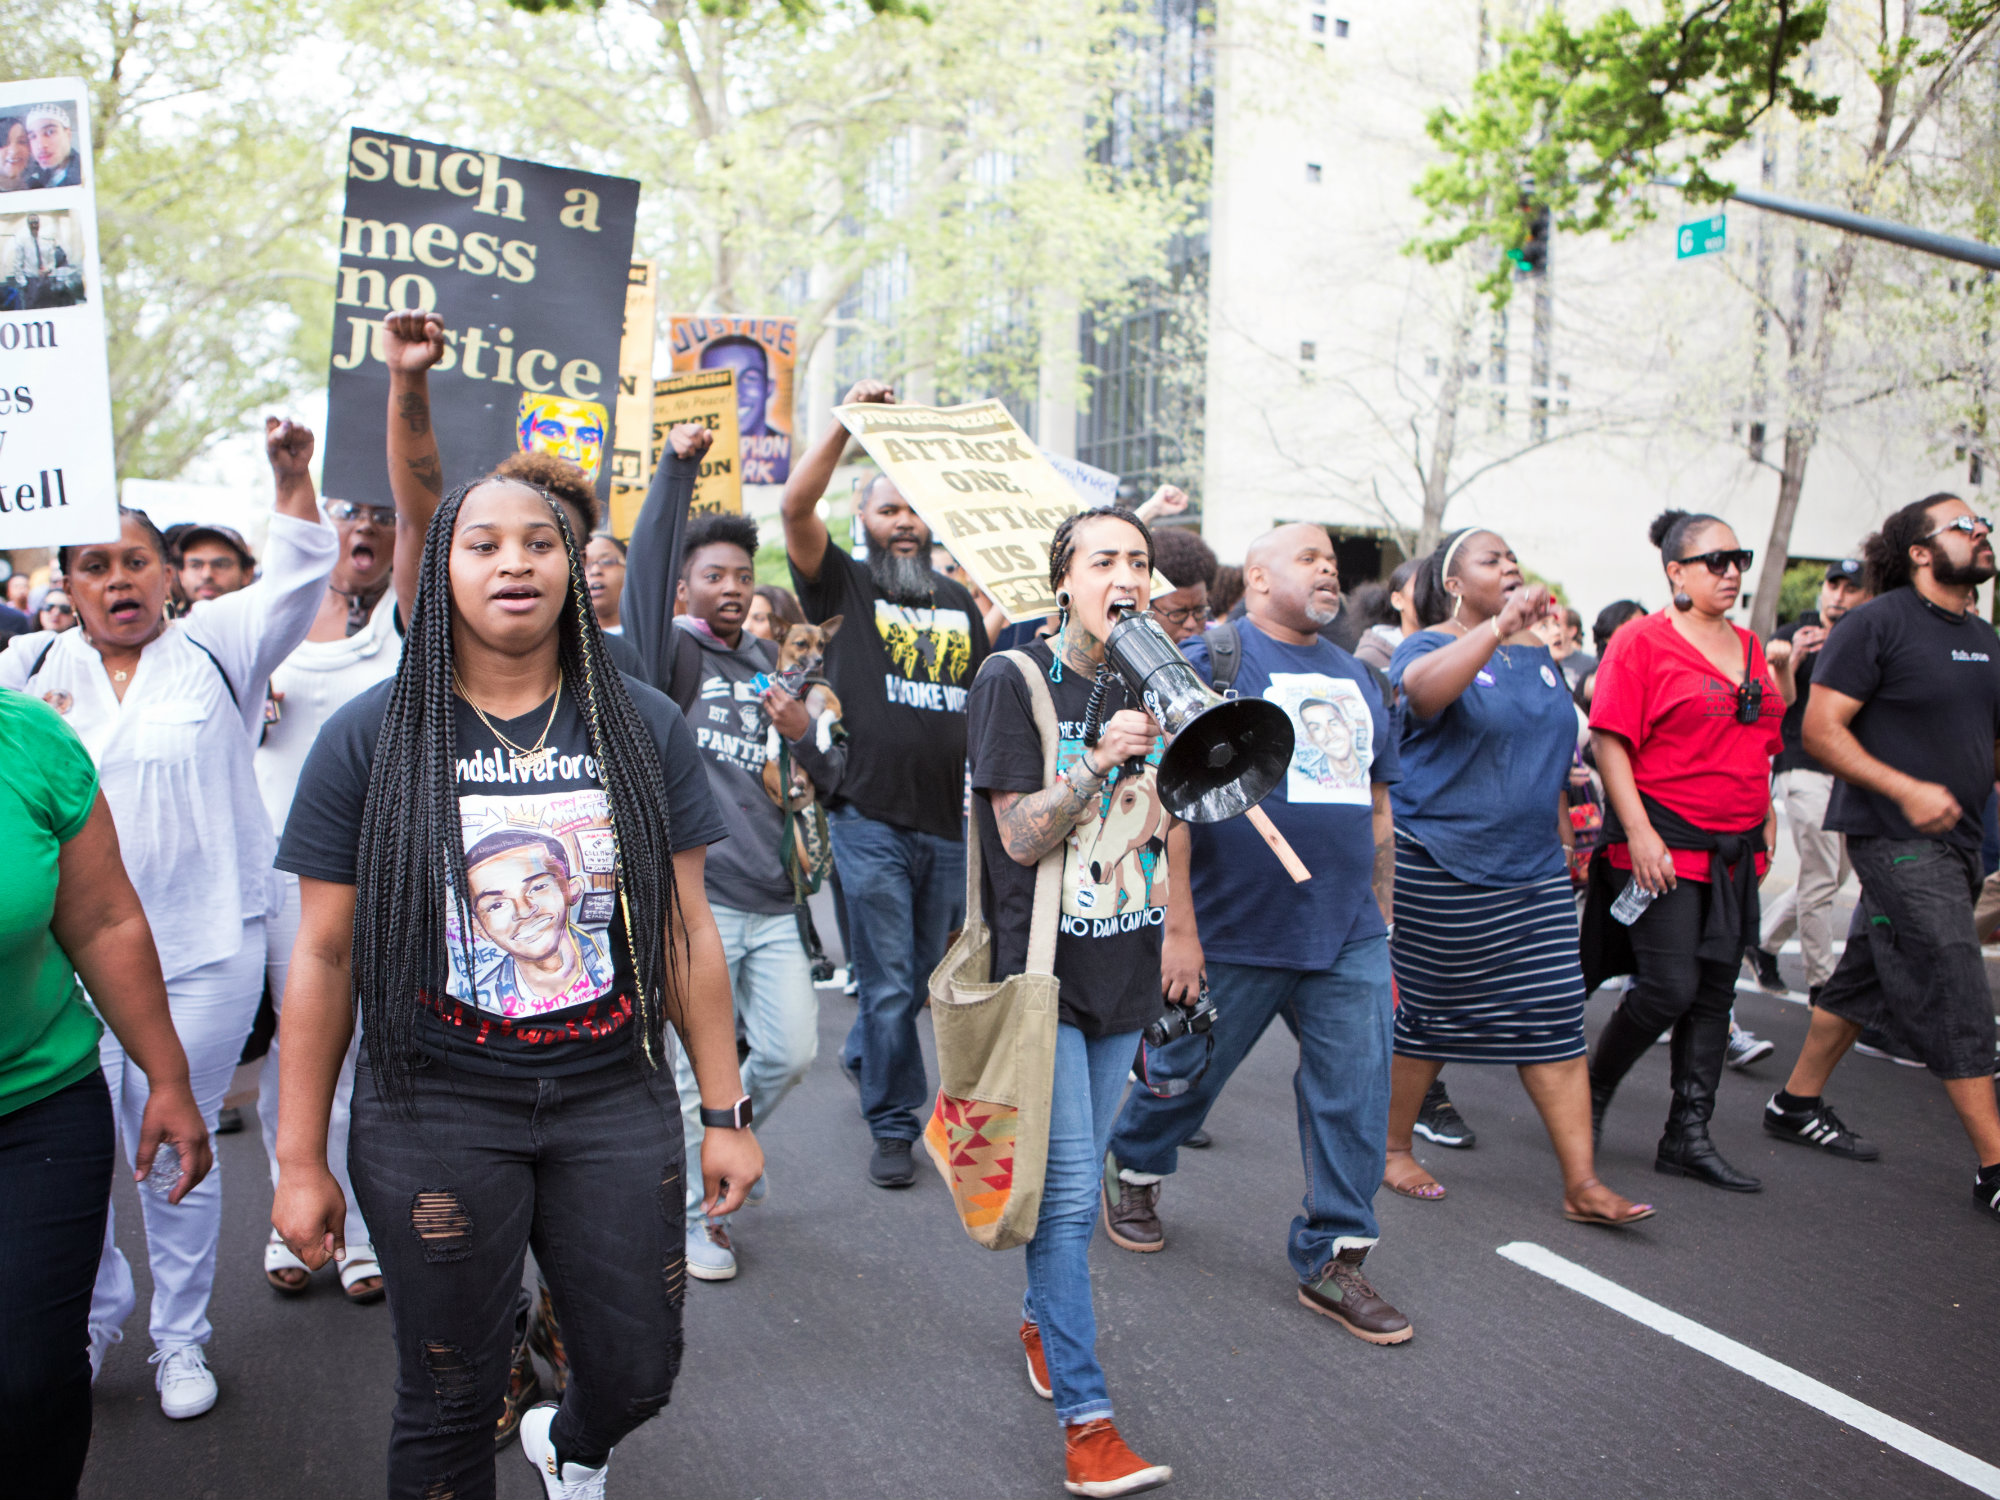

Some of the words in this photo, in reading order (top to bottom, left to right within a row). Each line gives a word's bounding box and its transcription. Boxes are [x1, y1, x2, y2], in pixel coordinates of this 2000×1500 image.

[349, 136, 526, 222] such
[559, 188, 602, 232] a
[340, 216, 538, 283] mess
[1680, 229, 1694, 254] G
[336, 266, 436, 313] no
[673, 319, 796, 355] JUSTICE
[883, 437, 1032, 463] ATTACK
[941, 470, 1032, 498] ONE,
[977, 545, 1037, 573] US
[885, 674, 944, 710] WOKE
[1060, 914, 1089, 937] NO
[1093, 916, 1118, 938] DAM
[1120, 911, 1142, 932] CAN
[1142, 906, 1166, 926] HO
[502, 996, 526, 1016] 20
